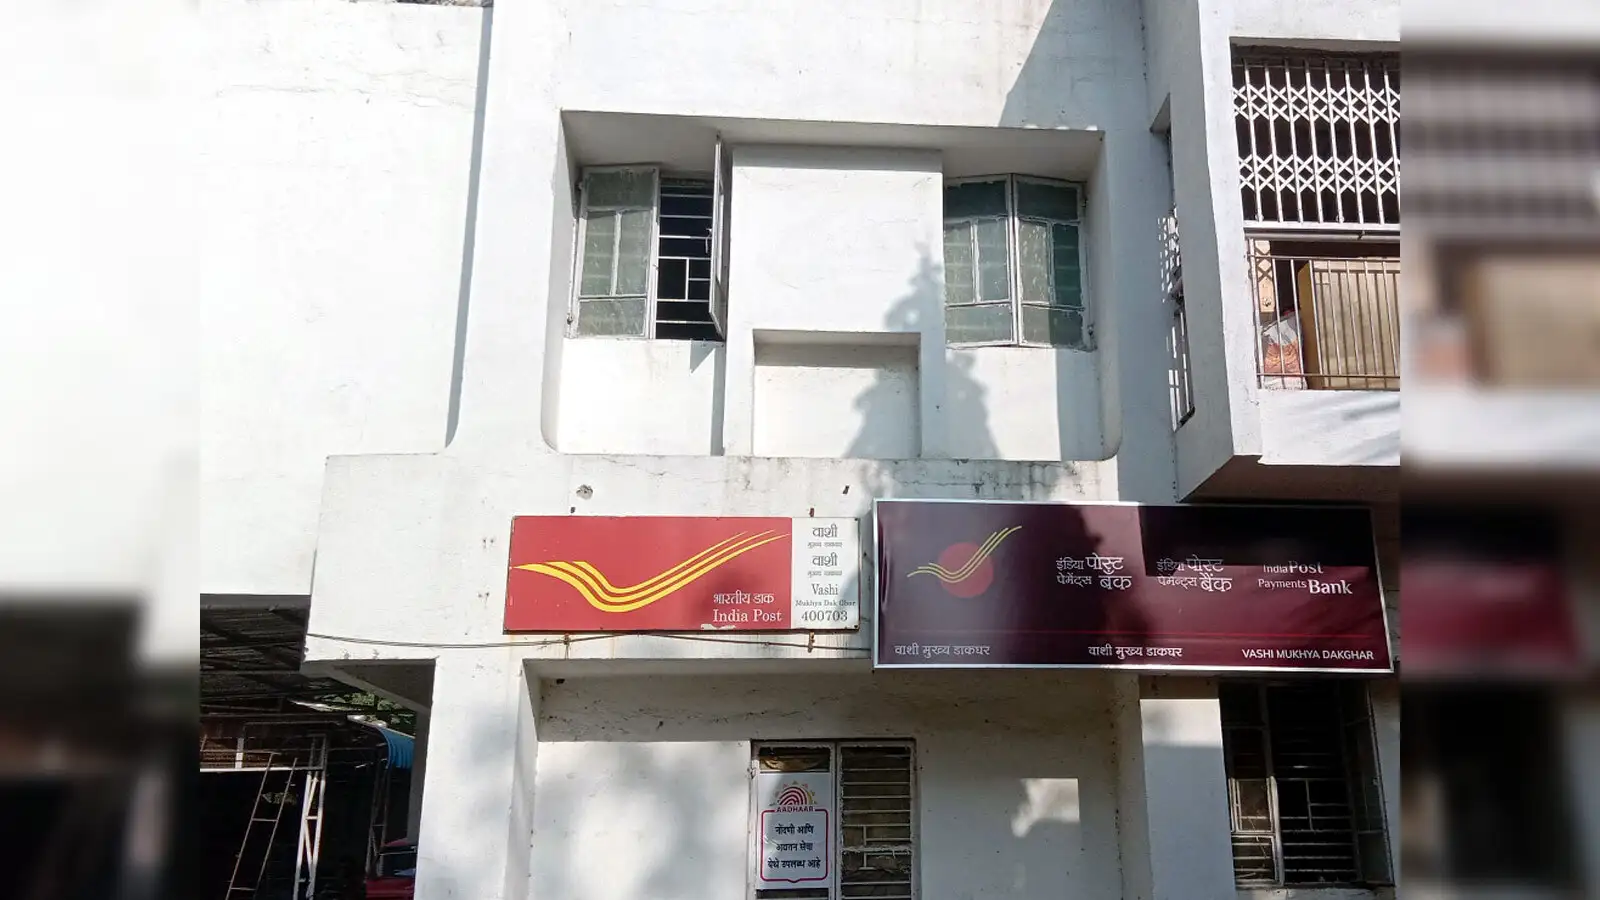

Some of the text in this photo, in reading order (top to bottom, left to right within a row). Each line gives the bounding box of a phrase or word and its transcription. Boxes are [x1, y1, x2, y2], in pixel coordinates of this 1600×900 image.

[812, 523, 838, 538] वाशी
[812, 551, 838, 567] वाशी
[1056, 552, 1124, 571] इंडिया पोस्ट
[1156, 554, 1224, 572] इंडिया पोस्ट
[1263, 560, 1324, 574] India Post
[811, 583, 839, 595] Vashi
[1199, 572, 1232, 592] बैंक
[1258, 579, 1353, 594] Payments Bank
[713, 589, 775, 604] भारतीय डाक
[713, 608, 783, 622] India Post
[801, 610, 848, 622] 400703
[894, 642, 990, 659] वाशी मुख्य डाकघर
[1088, 643, 1184, 660] वाशी मुख्य डाकघर
[1242, 649, 1374, 660] VASHI MUKHYA DAKGHAR
[800, 840, 814, 851] सेवा
[807, 857, 821, 869] आहे
